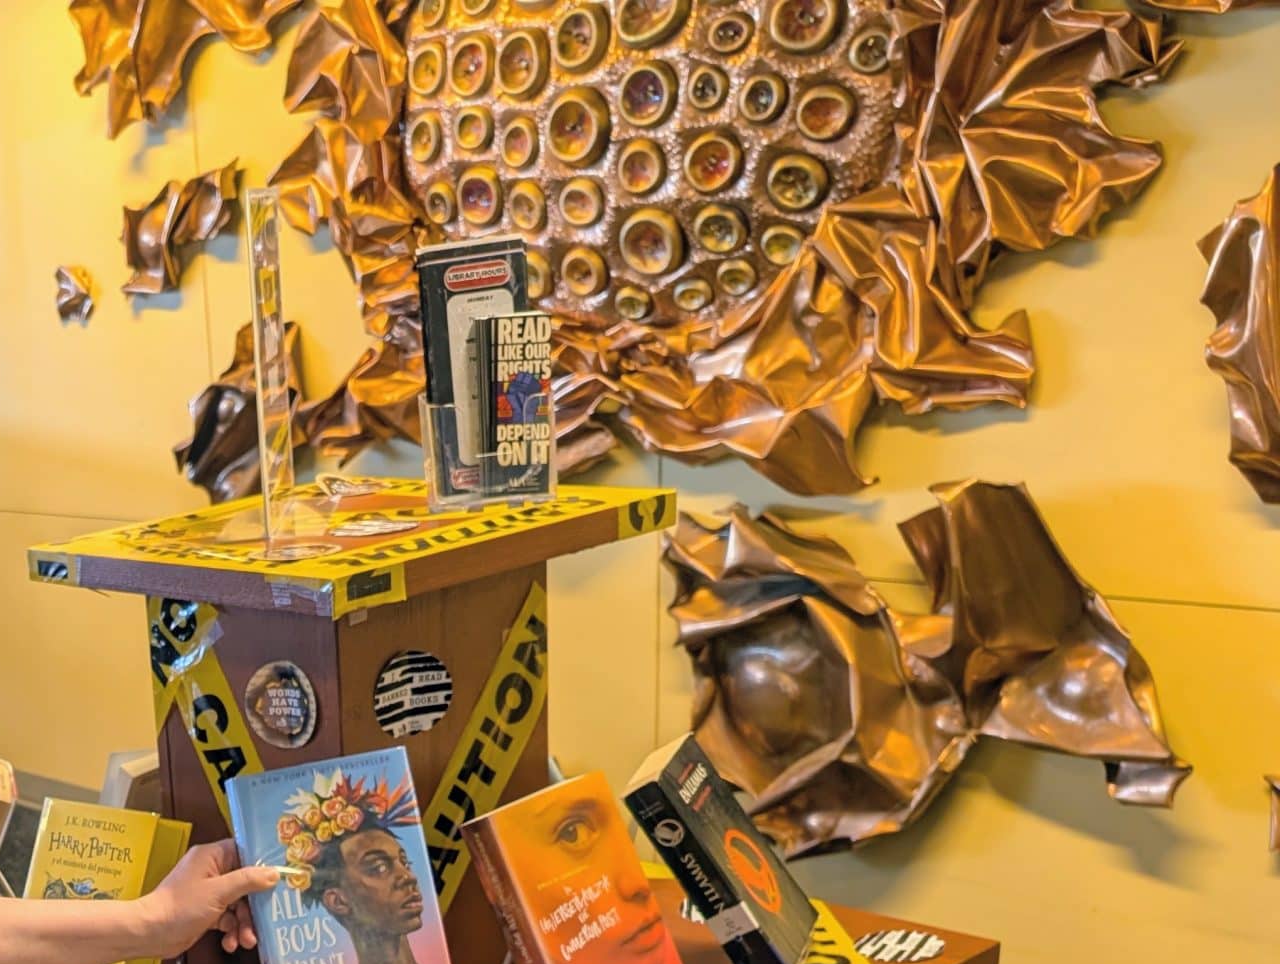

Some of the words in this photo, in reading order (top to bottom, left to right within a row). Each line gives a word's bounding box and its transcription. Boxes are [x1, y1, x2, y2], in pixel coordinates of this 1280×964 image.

[498, 316, 552, 345] READ
[497, 345, 524, 361] LIKE
[525, 343, 551, 360] OUR
[497, 360, 552, 383] RIGHTS
[497, 423, 550, 442] DEPEND
[496, 443, 527, 467] ON
[531, 442, 551, 465] IT
[417, 671, 443, 683] READ
[267, 688, 301, 698] WORDS
[381, 688, 409, 704] BANNED
[409, 695, 439, 706] BOOKS
[271, 698, 299, 707] HAVE
[269, 707, 302, 717] POWER
[428, 613, 547, 896] AUTION
[685, 763, 709, 797] LLAMAS
[678, 786, 693, 804] EN
[81, 818, 127, 834] ROWLING
[680, 852, 720, 904] LLAMAS
[271, 887, 307, 922] ALL
[275, 916, 337, 957] BOYS
